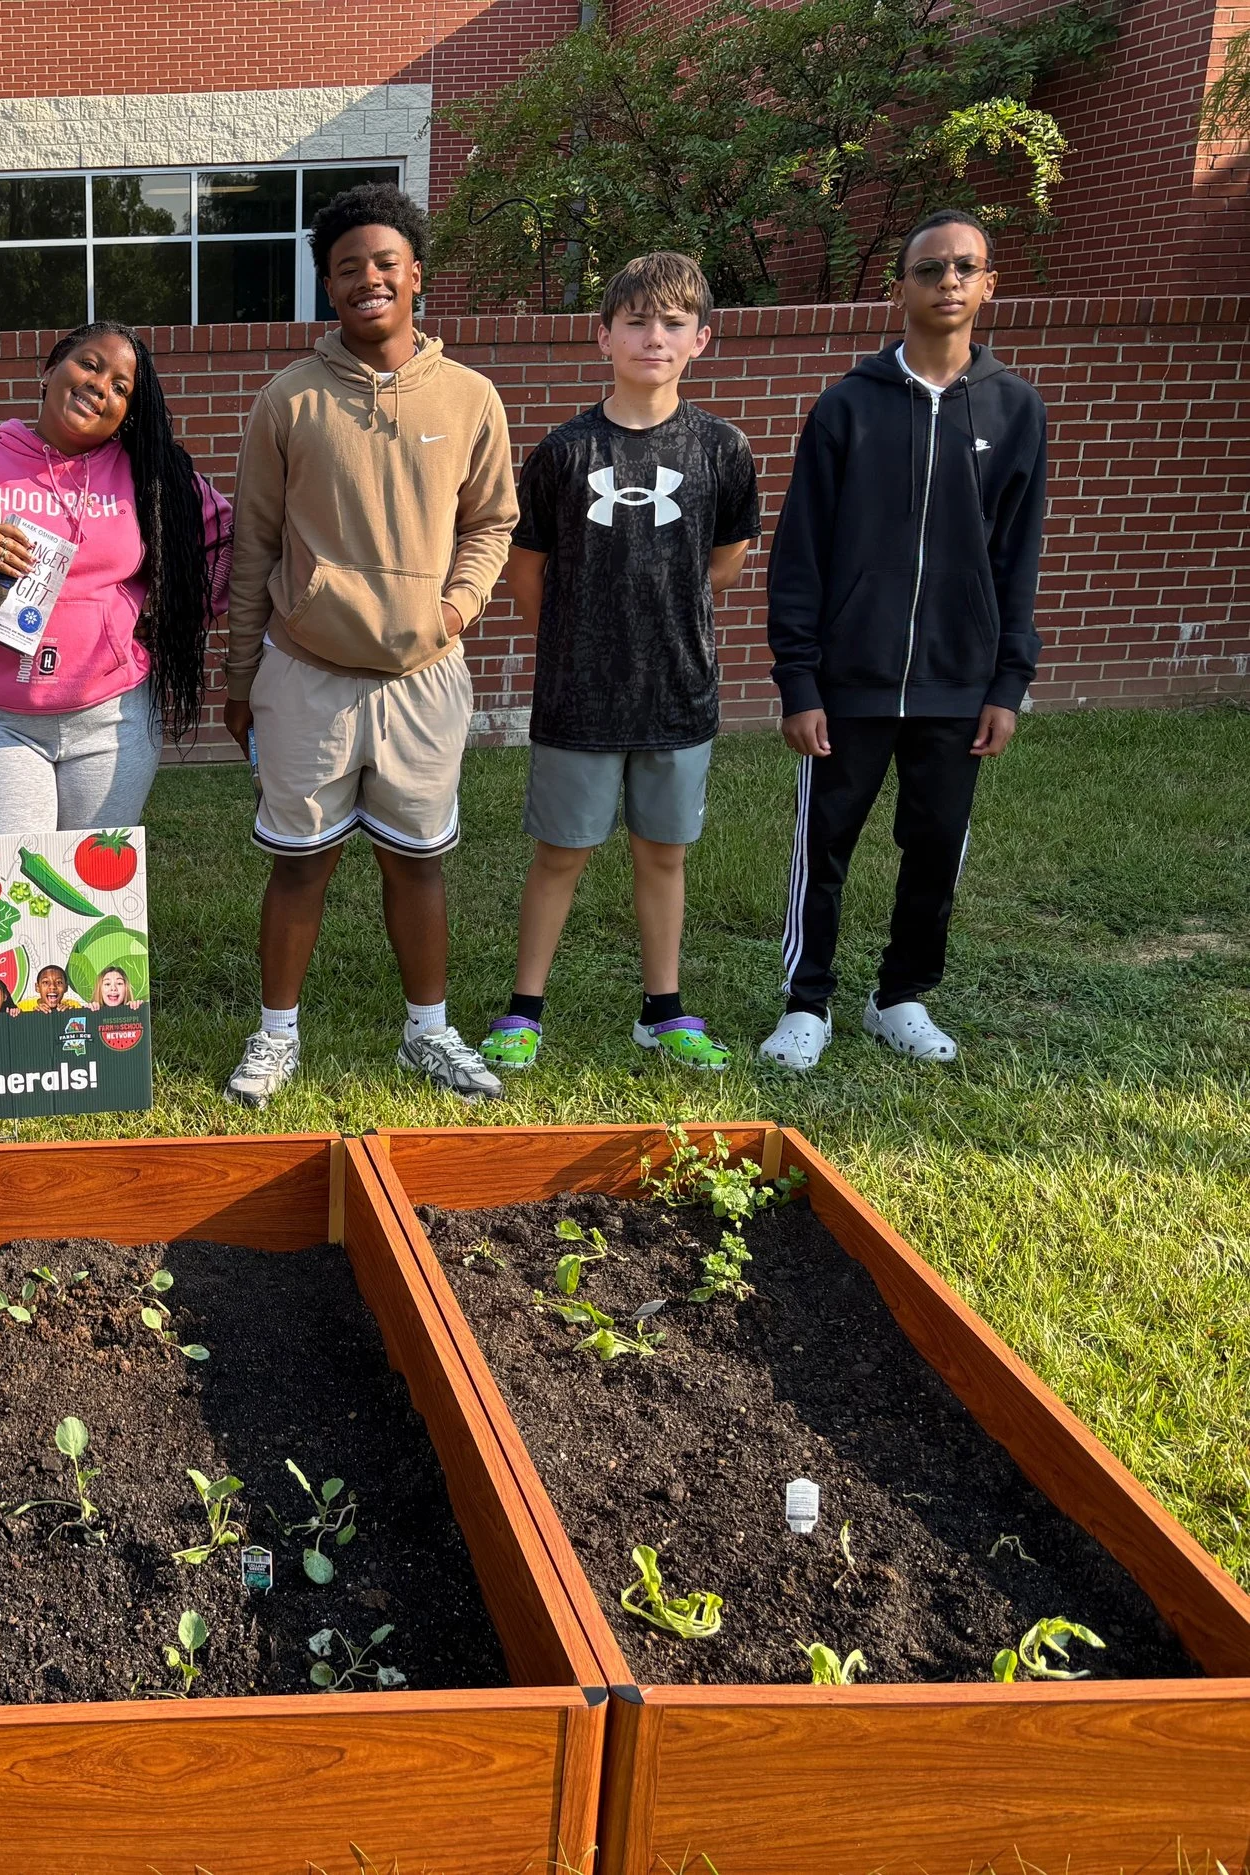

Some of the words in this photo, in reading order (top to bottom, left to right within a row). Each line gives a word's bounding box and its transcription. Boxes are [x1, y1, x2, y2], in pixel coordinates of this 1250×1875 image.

[22, 521, 38, 533] MARK
[38, 529, 59, 544] OSHIRO
[44, 572, 52, 584] A
[16, 575, 54, 606] GIFT
[102, 1016, 139, 1024] MISSISSIPPI
[98, 1024, 114, 1032] FARM
[120, 1023, 143, 1031] SCHOOL
[106, 1031, 137, 1040] NETWORK
